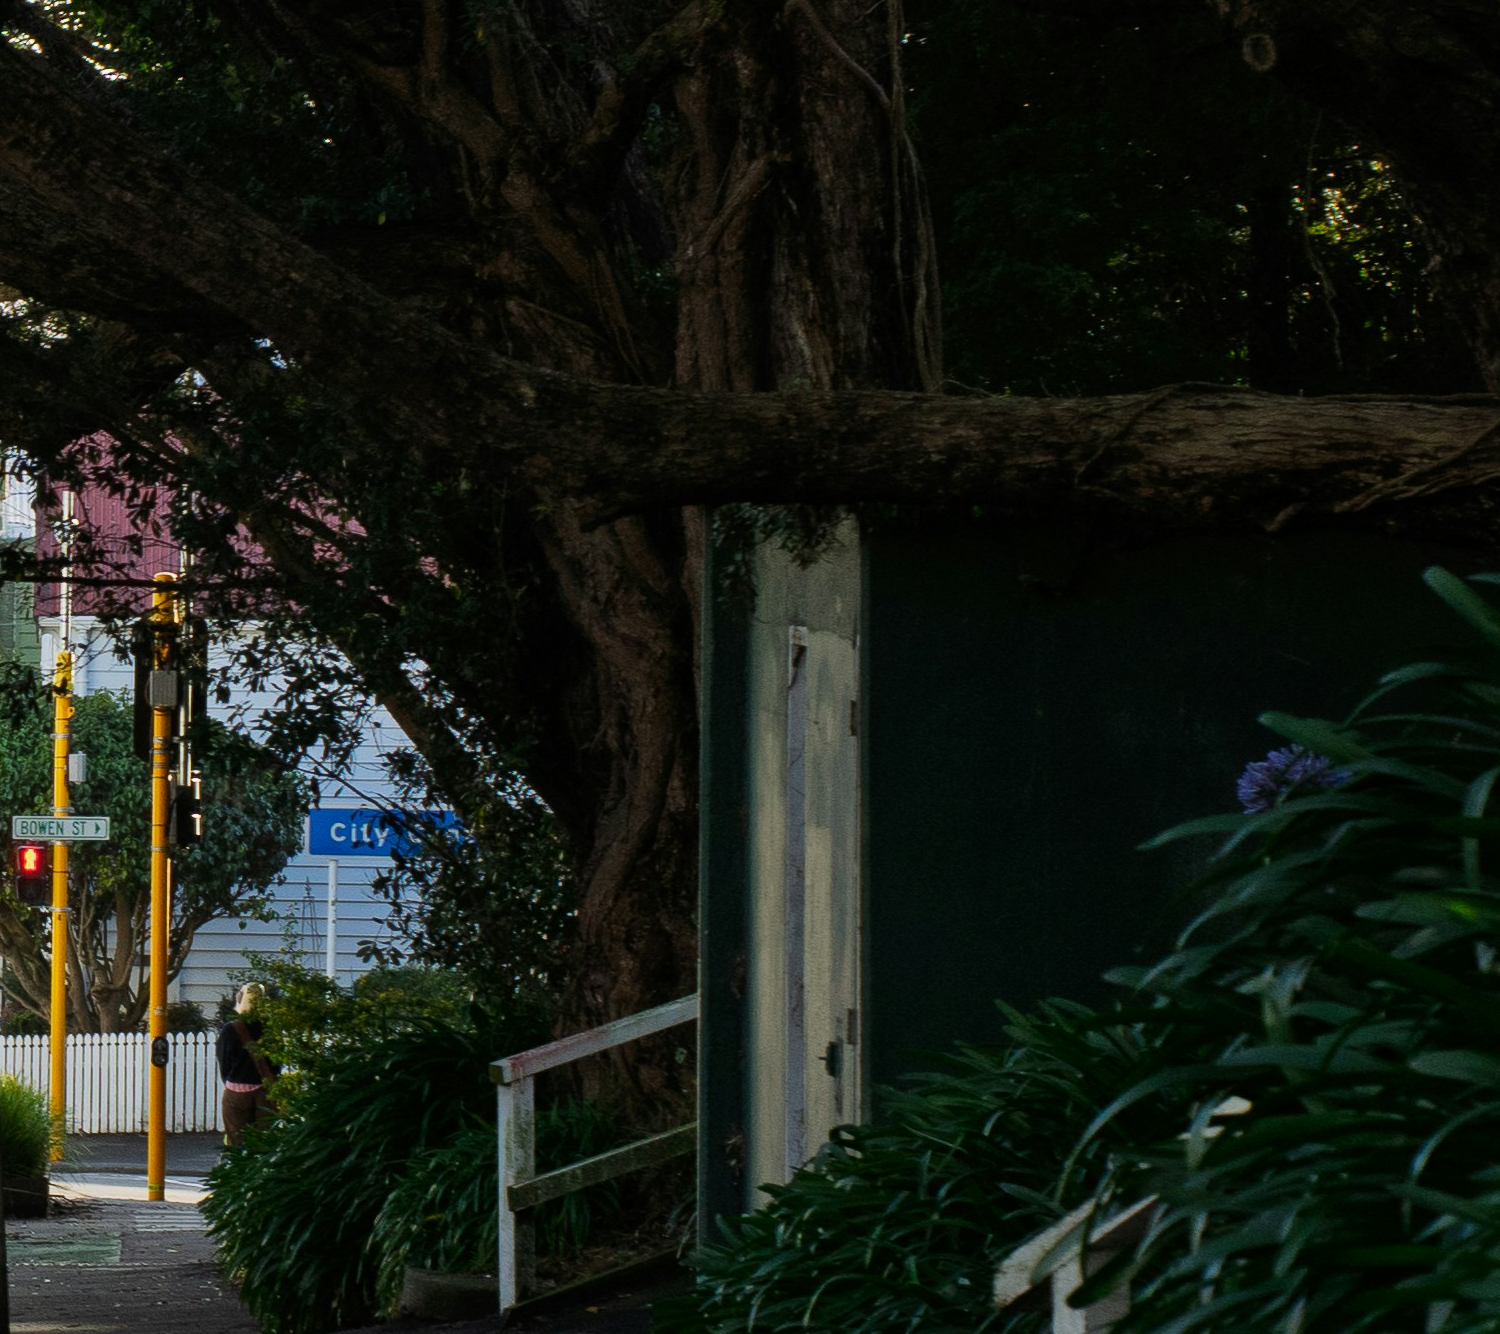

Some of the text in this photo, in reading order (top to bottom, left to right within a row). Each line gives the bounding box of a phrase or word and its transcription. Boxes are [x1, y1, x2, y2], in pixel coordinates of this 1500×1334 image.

[20, 821, 87, 835] BOWEN ST
[329, 822, 390, 847] City
